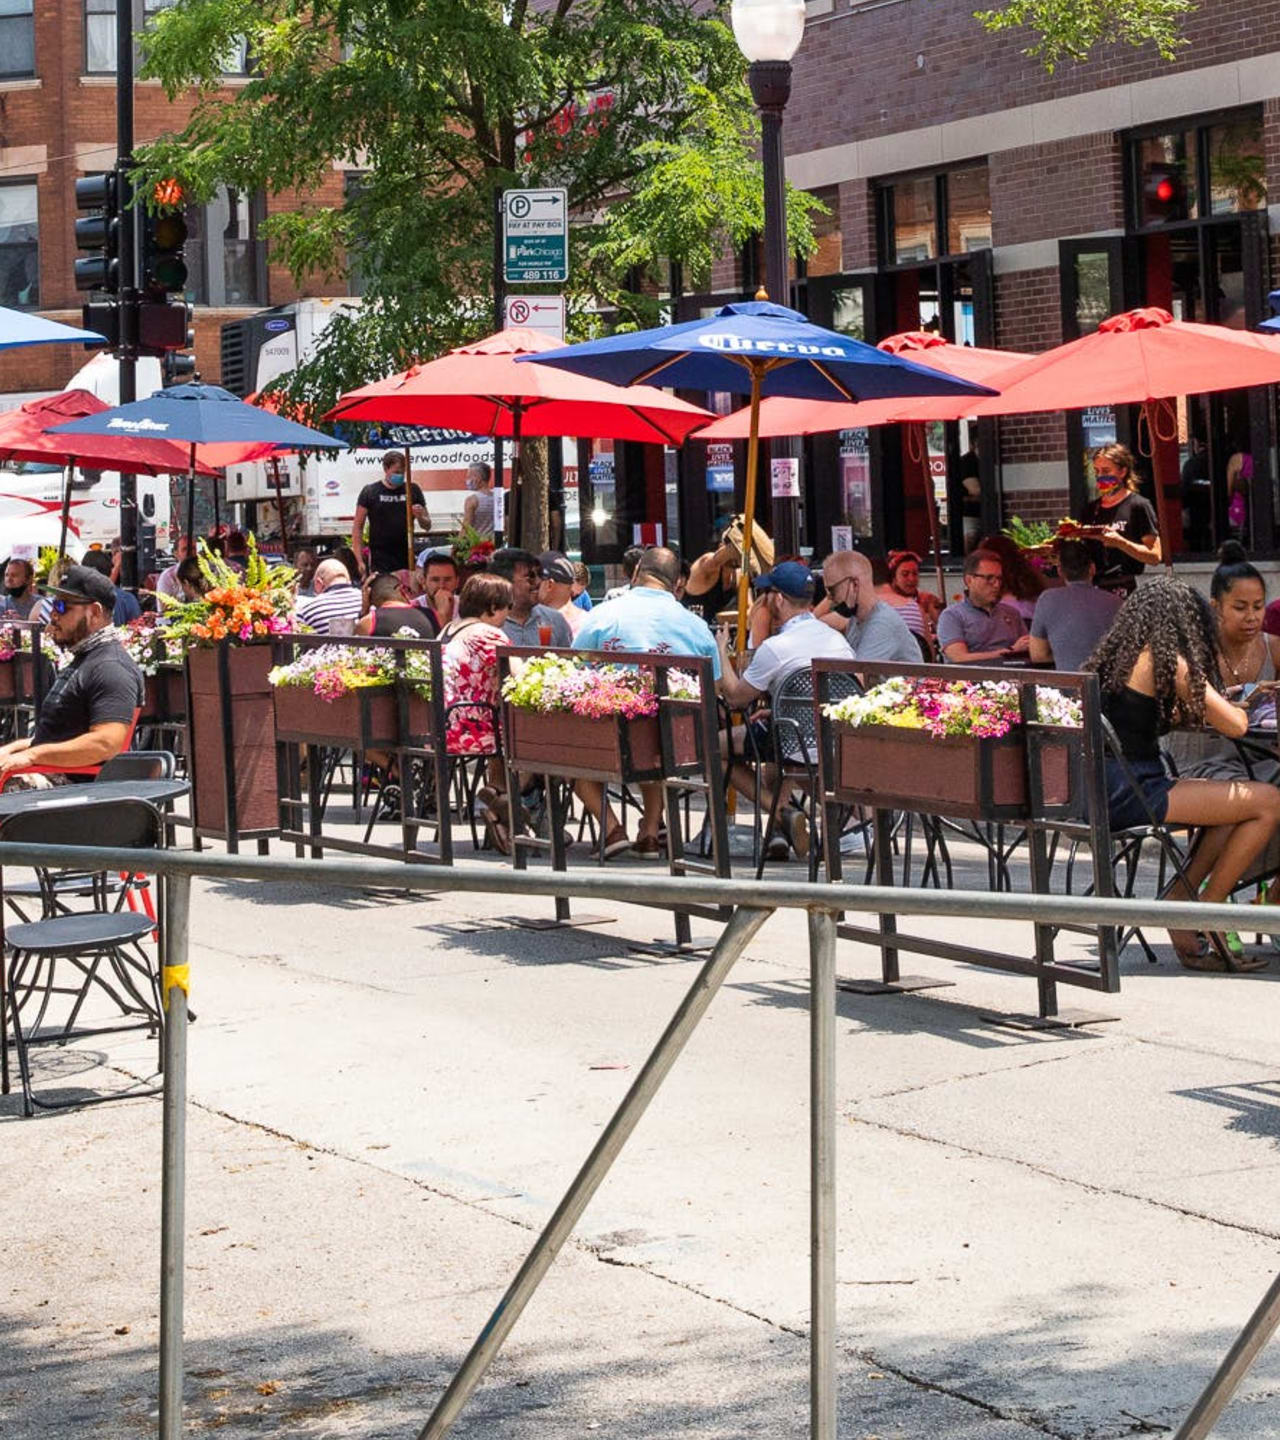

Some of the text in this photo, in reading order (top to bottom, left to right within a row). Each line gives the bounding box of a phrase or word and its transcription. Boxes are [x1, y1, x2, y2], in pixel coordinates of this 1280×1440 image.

[523, 271, 540, 279] 489
[542, 271, 559, 279] 116
[842, 430, 867, 440] BLACK
[845, 439, 865, 447] LIVES
